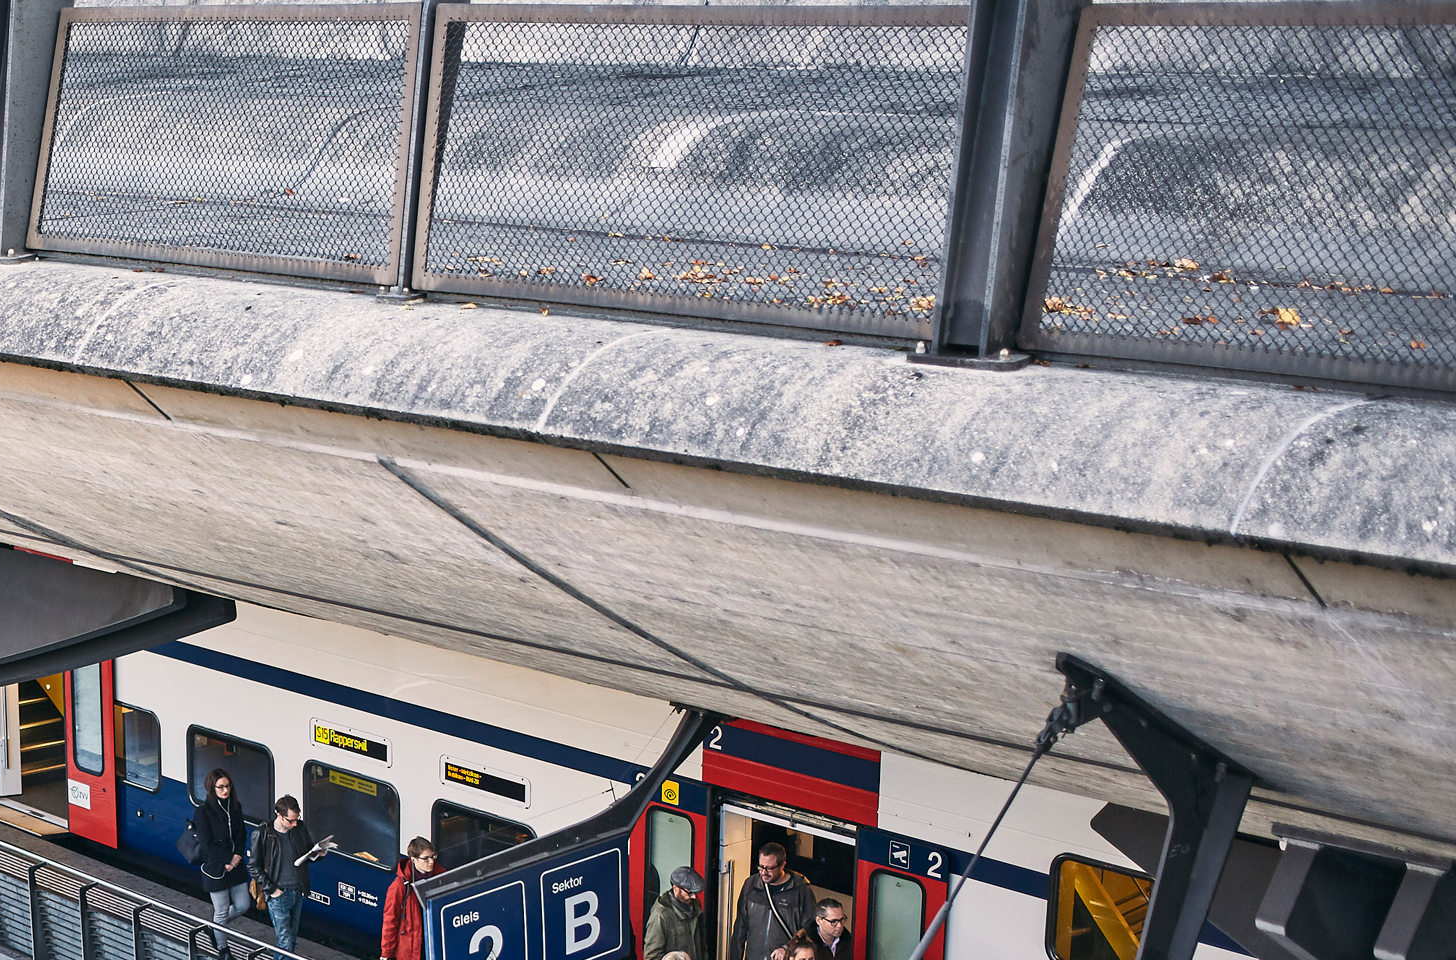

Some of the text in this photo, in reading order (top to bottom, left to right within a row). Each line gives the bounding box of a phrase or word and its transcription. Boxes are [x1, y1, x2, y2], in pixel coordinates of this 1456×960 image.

[316, 726, 368, 753] S15 Rapperswil
[709, 725, 723, 750] 2
[927, 851, 943, 879] 2
[552, 875, 583, 894] Sektor
[452, 910, 480, 928] Gleis
[564, 890, 601, 956] B
